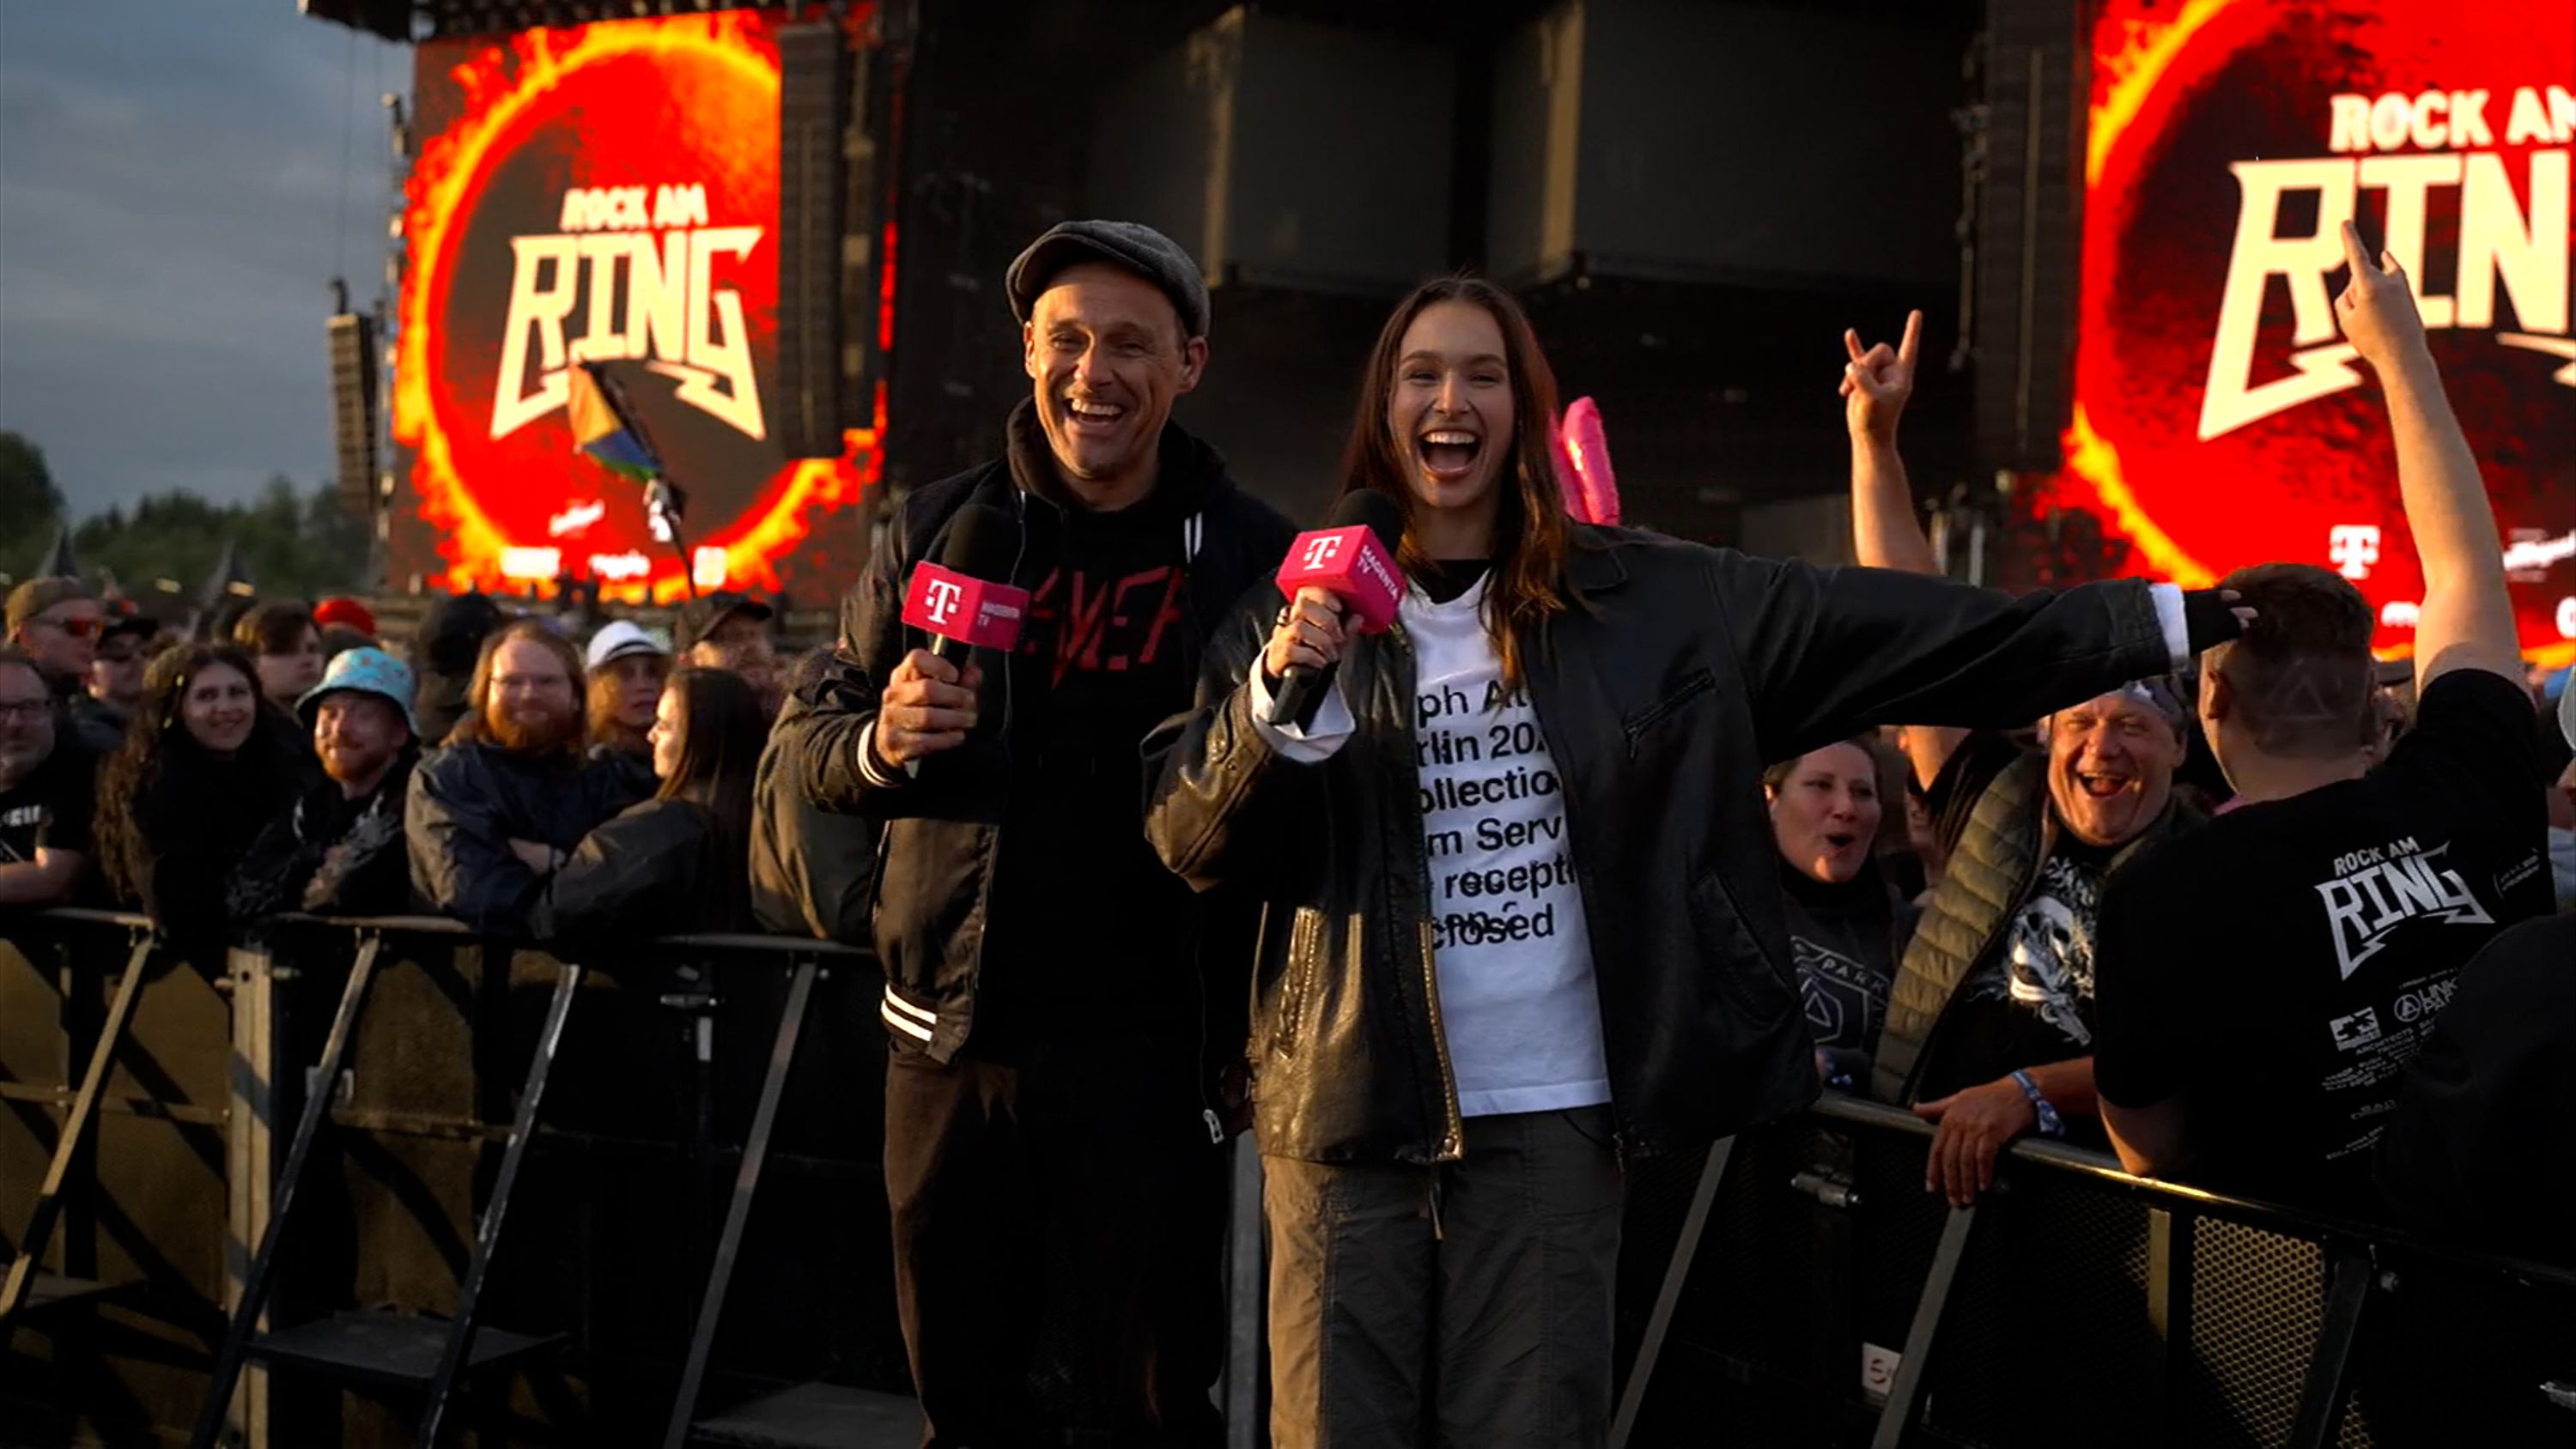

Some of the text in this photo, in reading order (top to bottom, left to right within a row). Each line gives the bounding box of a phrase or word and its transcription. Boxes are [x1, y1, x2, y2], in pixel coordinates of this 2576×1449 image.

[2329, 89, 2492, 152] ROCK
[561, 182, 708, 232] ROCK AM
[2196, 149, 2576, 443] RIN
[490, 226, 766, 441] RING
[1303, 536, 1343, 570] T
[1358, 555, 1371, 574] TV
[1361, 544, 1399, 600] MAGENTA
[924, 578, 963, 624] T
[977, 613, 991, 627] TV
[1417, 684, 1468, 728] ph
[1415, 722, 1545, 767] rlin 20
[1417, 767, 1559, 814] ollectio
[1426, 815, 1563, 857] m Serv
[2332, 834, 2422, 878] ROCK AM
[1444, 852, 1576, 899] recepti
[2313, 839, 2497, 983] RING
[2417, 975, 2459, 1003] LINK
